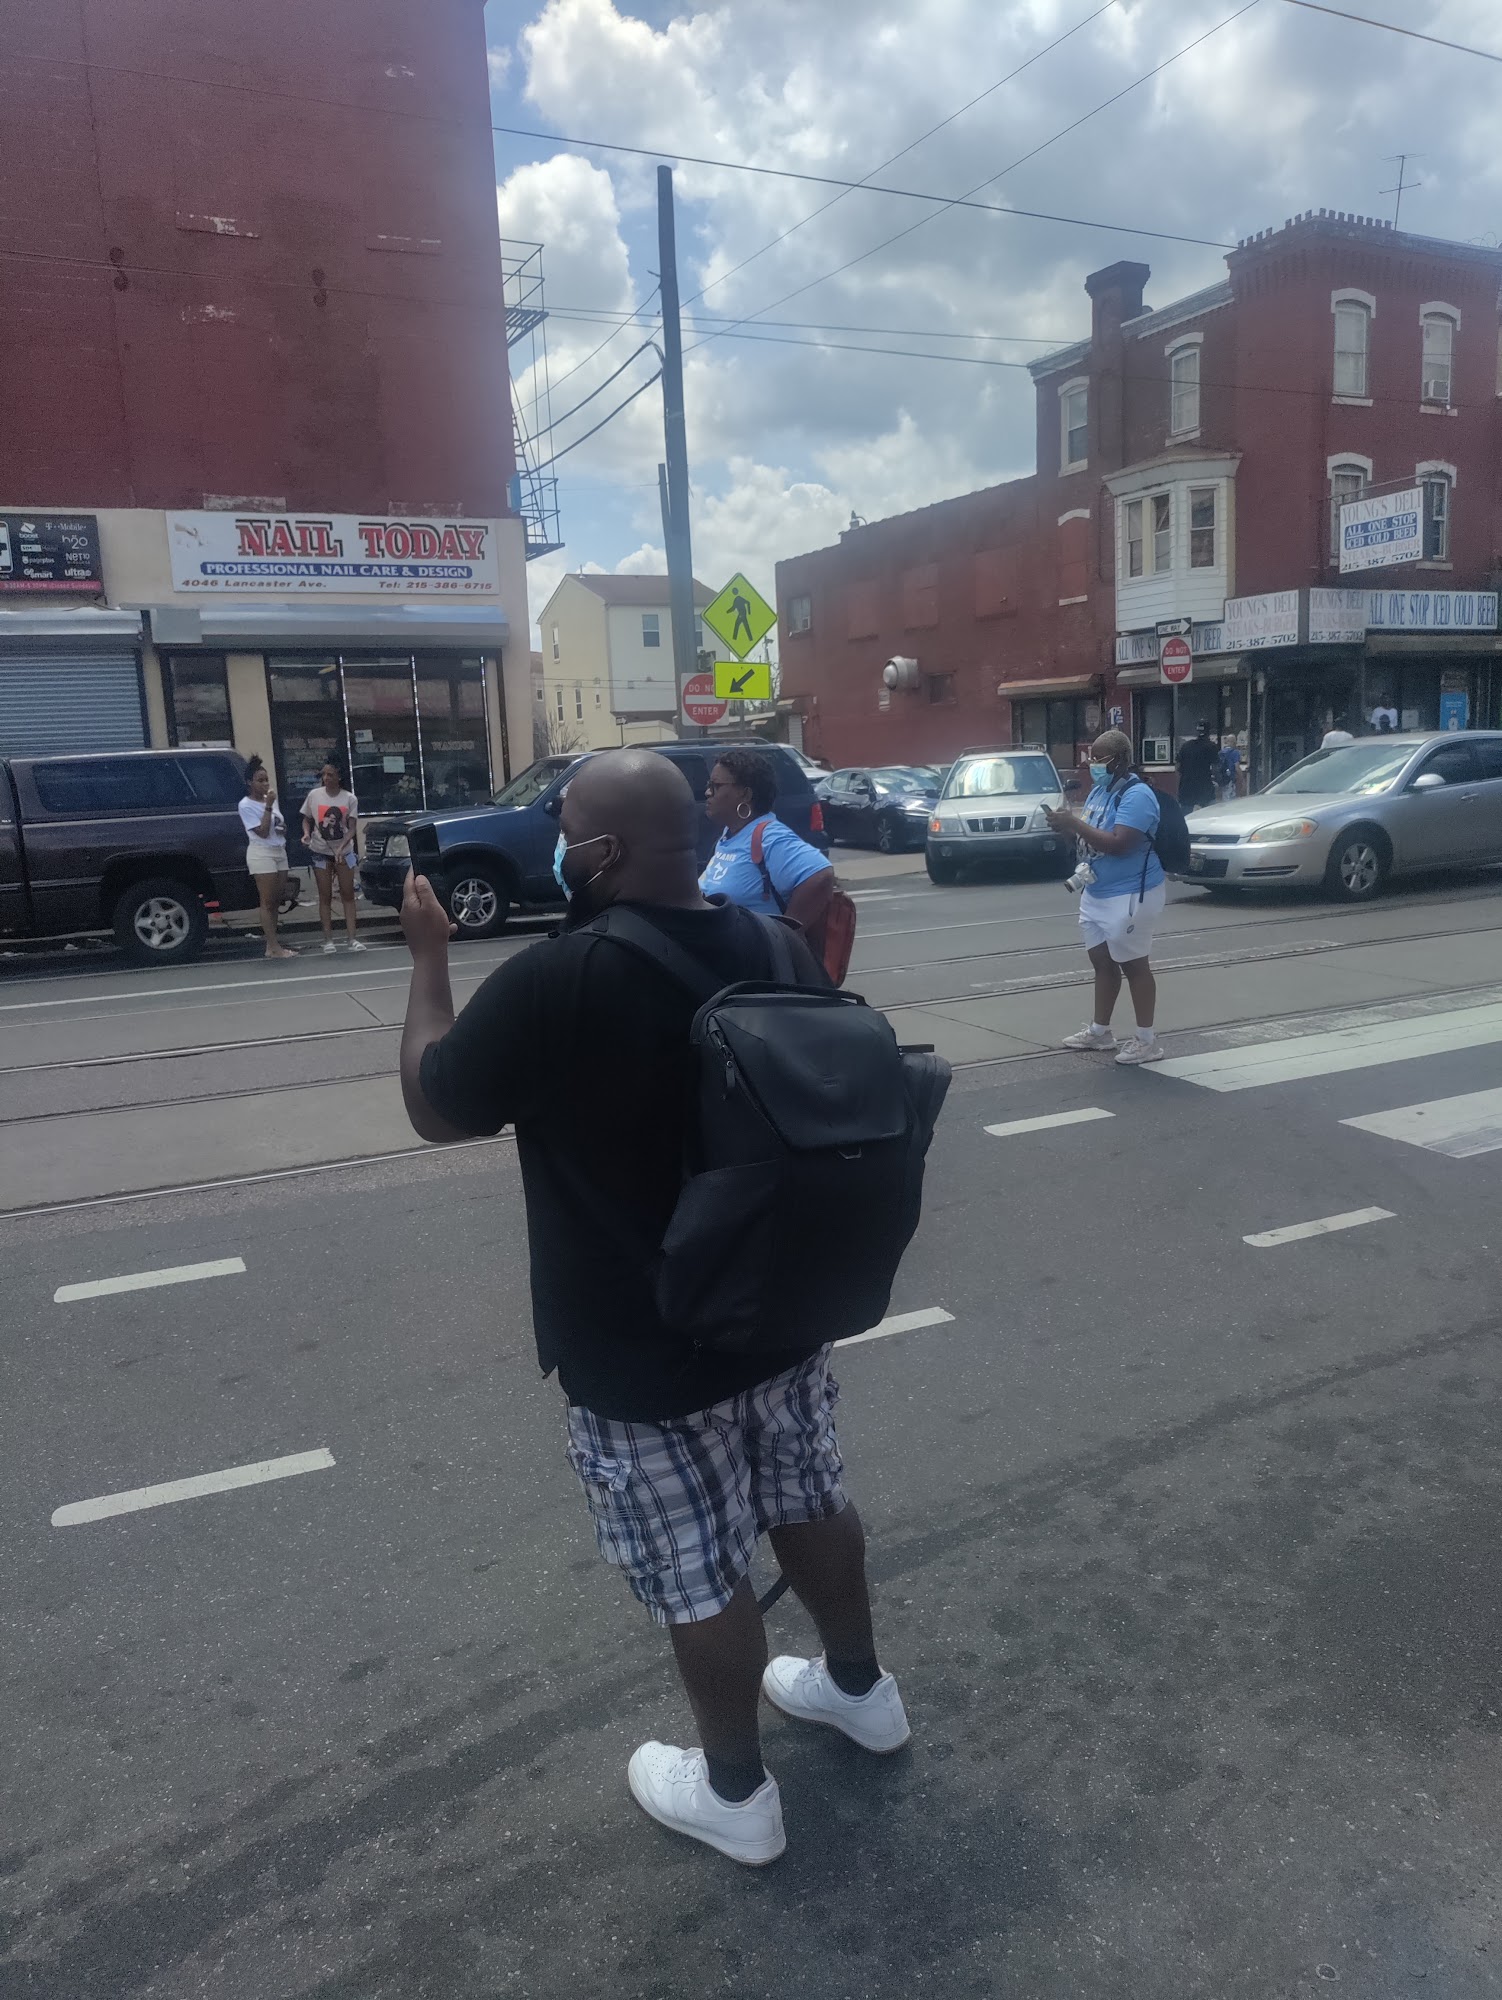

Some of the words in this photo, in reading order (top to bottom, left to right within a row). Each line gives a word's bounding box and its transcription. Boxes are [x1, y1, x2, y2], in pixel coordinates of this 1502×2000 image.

[1395, 491, 1421, 513] DELI
[1347, 525, 1364, 536] ALL
[1368, 518, 1388, 532] ONE
[1392, 513, 1416, 527] STOP
[235, 519, 343, 558] NAIL
[358, 522, 488, 560] TODAY
[1346, 536, 1365, 549] ICED
[1368, 531, 1390, 545] COLD
[1394, 527, 1415, 540] BEER
[206, 563, 318, 575] PROFESSIONAL
[321, 565, 357, 576] NAIL
[361, 566, 399, 576] CARE
[402, 566, 415, 577] &
[418, 567, 468, 577] DESIGN
[181, 579, 219, 587] 4046
[224, 579, 293, 588] Lancaster
[379, 581, 401, 589] Tel:
[406, 581, 492, 590] 215-386-6715
[1226, 597, 1268, 621] YOUNG'S
[1274, 592, 1297, 614] DELI
[1346, 590, 1364, 610] DELI
[1368, 593, 1384, 625] ALL
[1389, 593, 1406, 625] ONE
[1409, 594, 1430, 625] STOP
[1433, 594, 1451, 625] ICED
[1454, 595, 1474, 625] COLD
[1477, 595, 1496, 626] BEER
[1117, 639, 1129, 661] ALL
[1131, 636, 1144, 659] ONE
[1203, 627, 1221, 651] BEER
[1226, 633, 1297, 650] 215-387-5702
[1311, 631, 1363, 641] 215-387-5702
[1176, 647, 1187, 655] NOT
[1168, 666, 1186, 675] ENTER
[689, 685, 700, 693] DO
[705, 685, 714, 693] NO
[693, 707, 718, 716] ENTER
